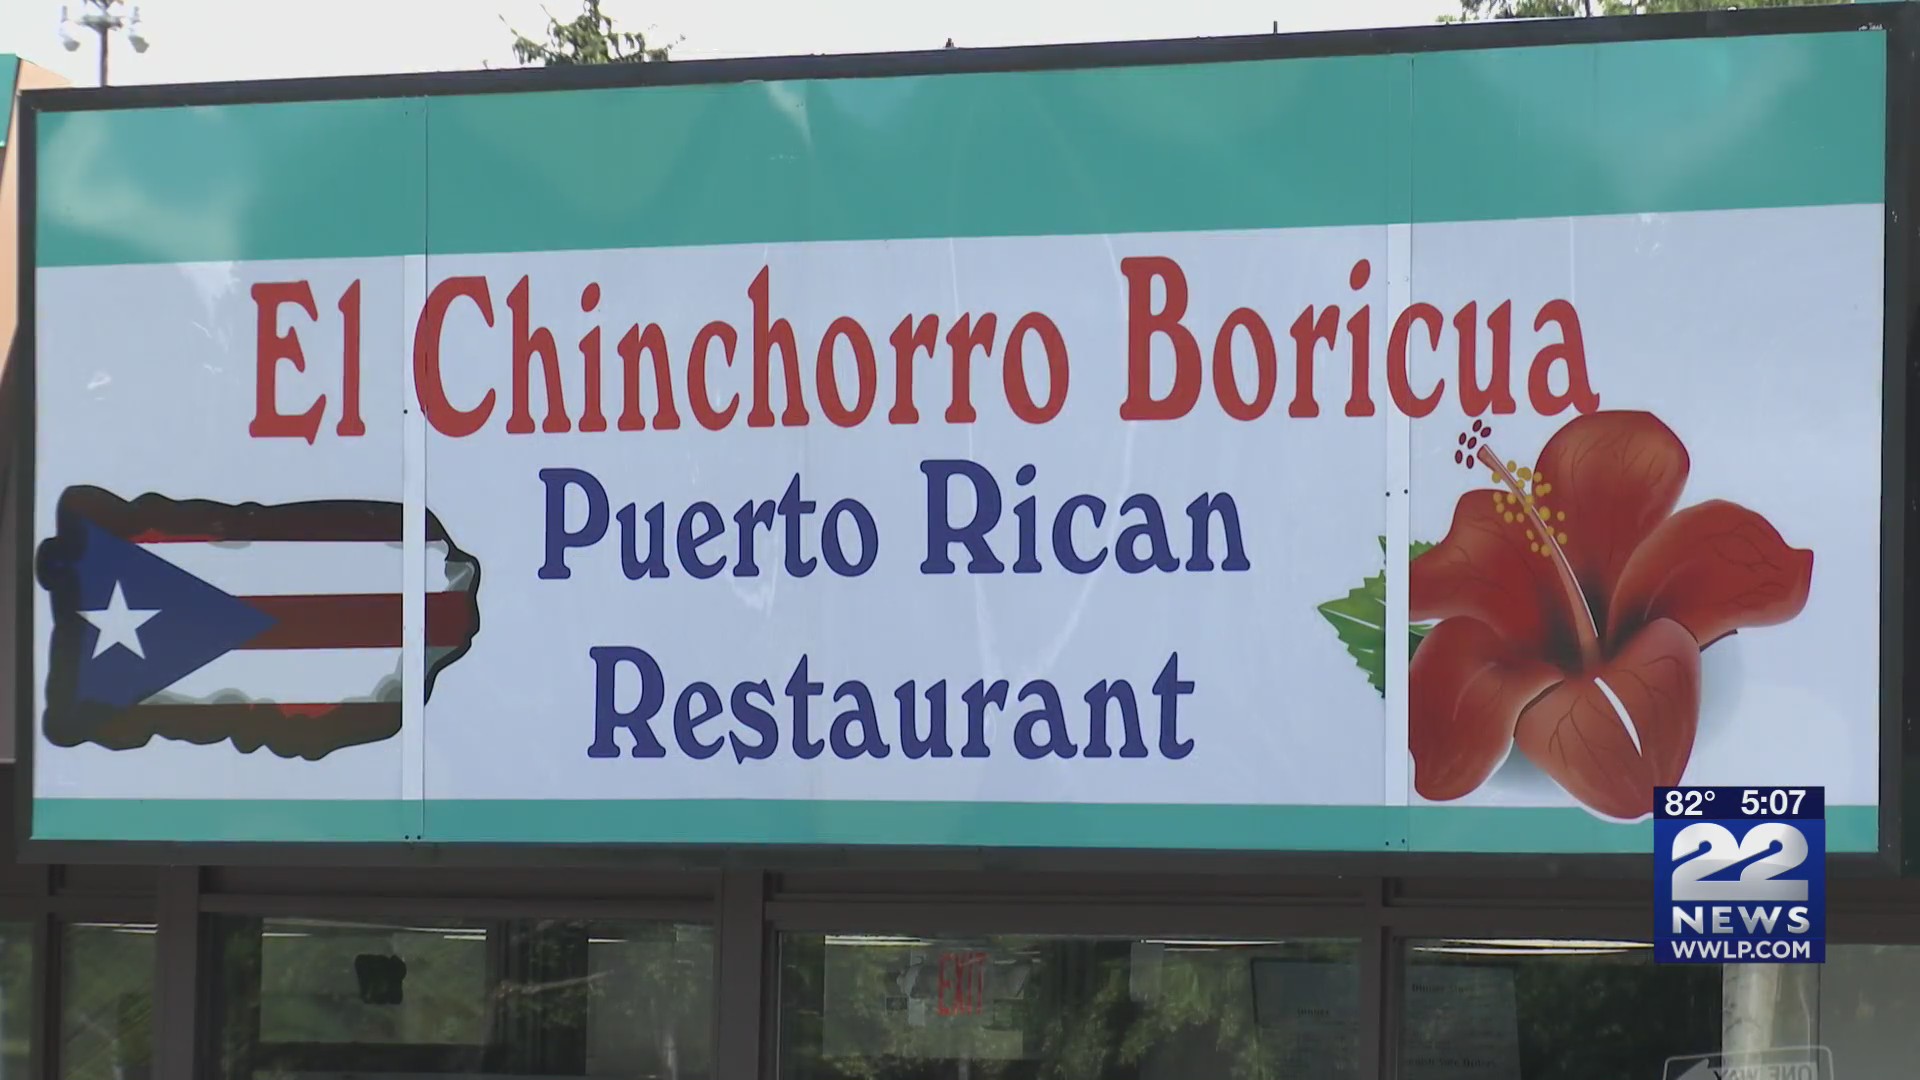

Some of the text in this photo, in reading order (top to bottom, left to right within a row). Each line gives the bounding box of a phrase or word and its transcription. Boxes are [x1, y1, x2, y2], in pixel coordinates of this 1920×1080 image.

[249, 256, 1600, 444] El Chinchorro Boricua
[536, 458, 1251, 581] Puerto Rican
[586, 645, 1196, 766] Restaurant
[938, 951, 990, 1017] EXIT
